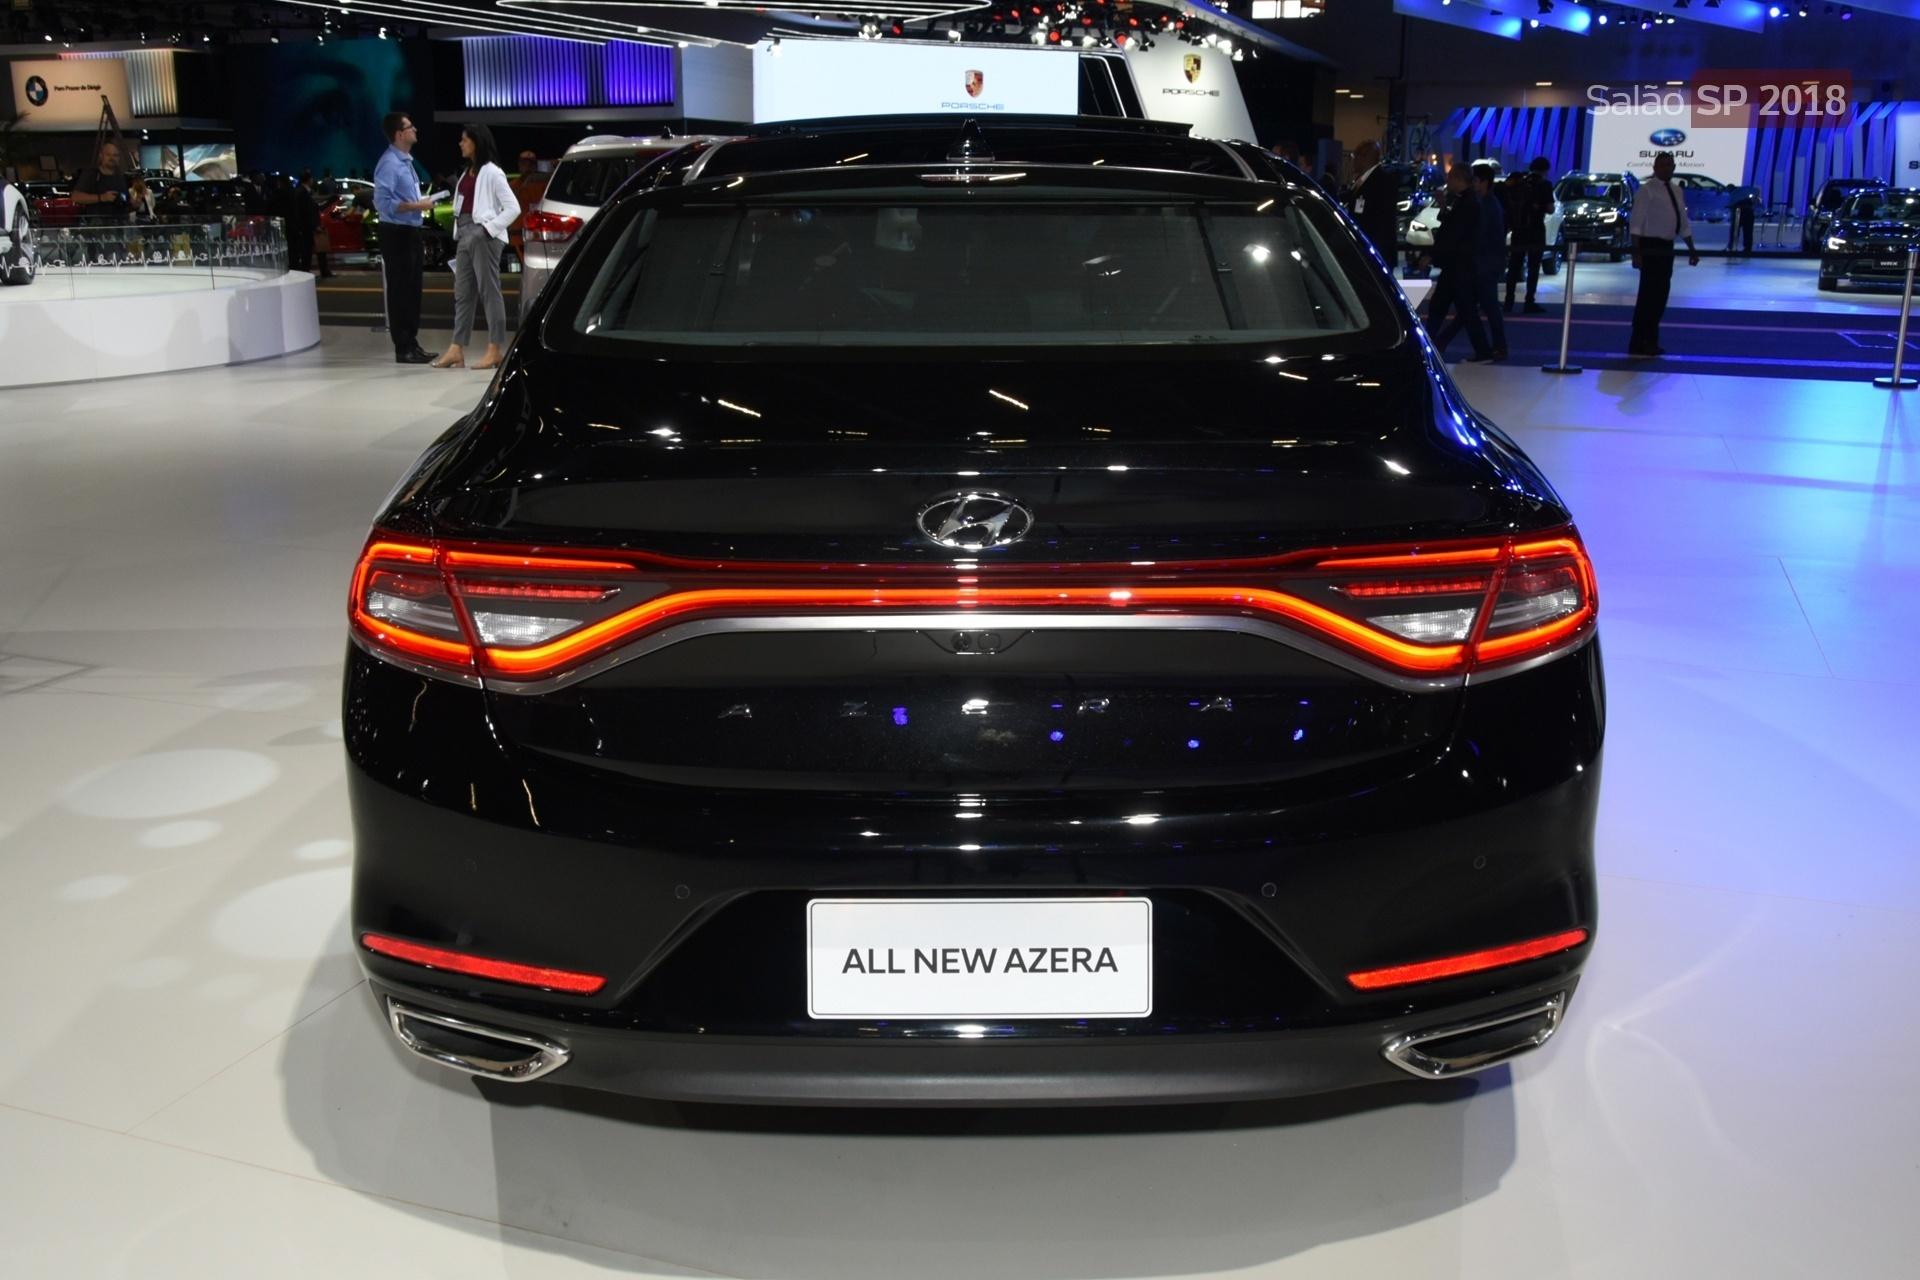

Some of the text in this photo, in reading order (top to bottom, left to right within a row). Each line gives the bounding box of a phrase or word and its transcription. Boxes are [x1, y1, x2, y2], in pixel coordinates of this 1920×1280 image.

[1162, 88, 1220, 96] PORSCHE
[941, 102, 1005, 110] PORSCHE
[842, 947, 1119, 974] ALL NEW AZERA
